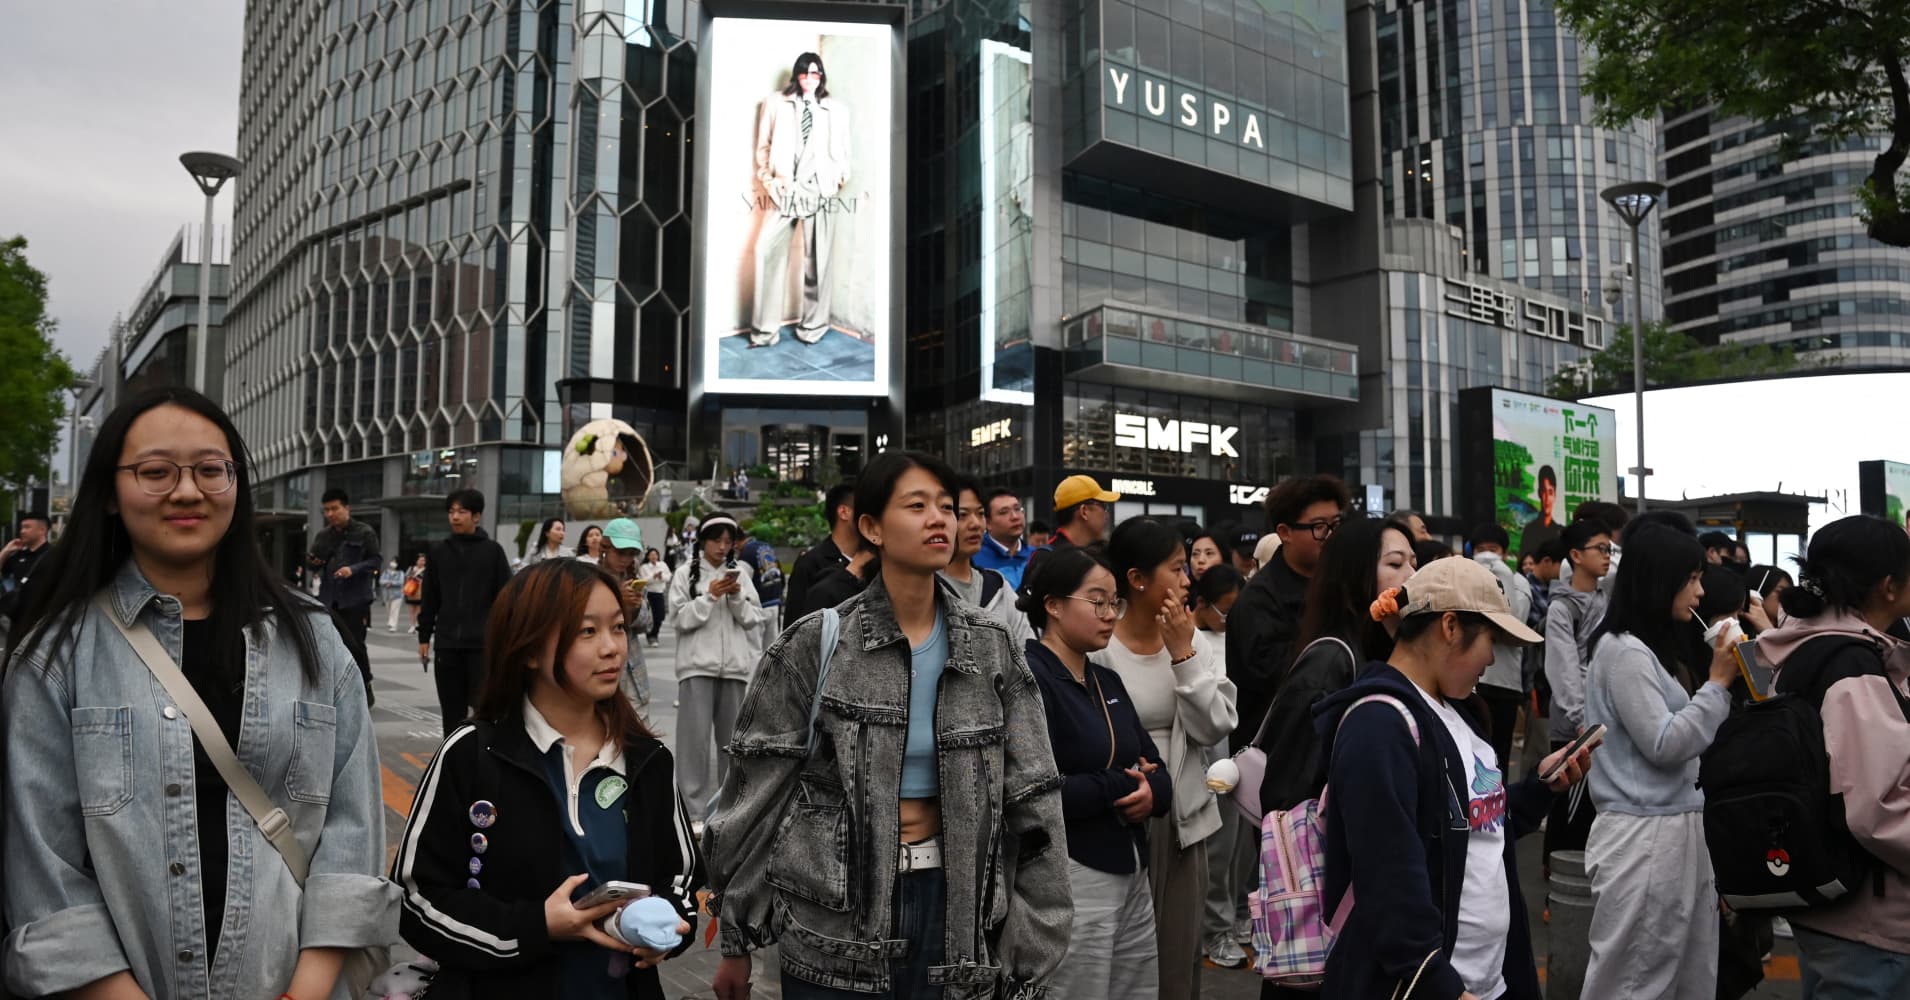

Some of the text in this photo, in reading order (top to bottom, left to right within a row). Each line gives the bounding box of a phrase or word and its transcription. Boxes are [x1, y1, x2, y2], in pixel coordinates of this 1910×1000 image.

[1109, 67, 1264, 149] YUSPA
[1446, 277, 1605, 350] 三里屯 SOHO
[971, 417, 1012, 447] SMFK
[1114, 413, 1240, 458] SMFK
[1562, 408, 1598, 438] 下一个
[1564, 455, 1600, 496] 你来
